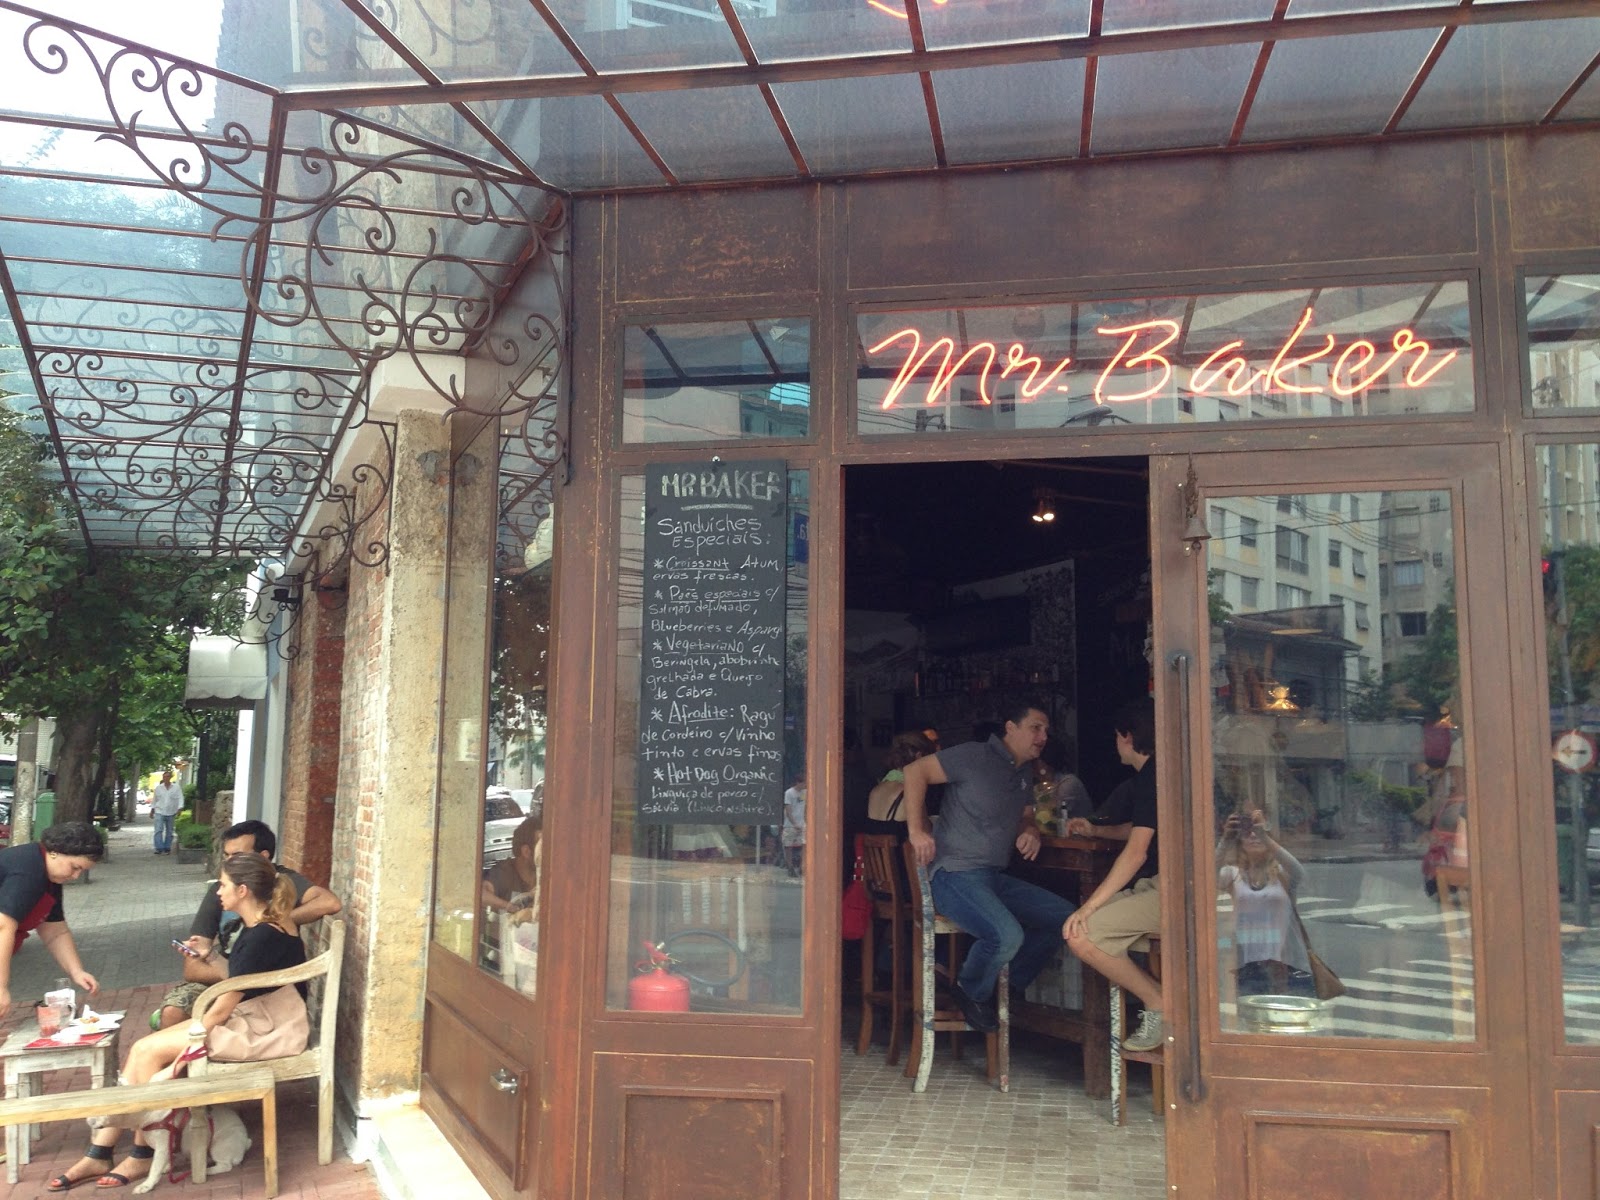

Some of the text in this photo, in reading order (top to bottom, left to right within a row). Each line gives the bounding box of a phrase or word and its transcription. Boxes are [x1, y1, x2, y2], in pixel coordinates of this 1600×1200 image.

[869, 307, 1458, 410] Mr. Baker
[700, 470, 781, 501] BAKER
